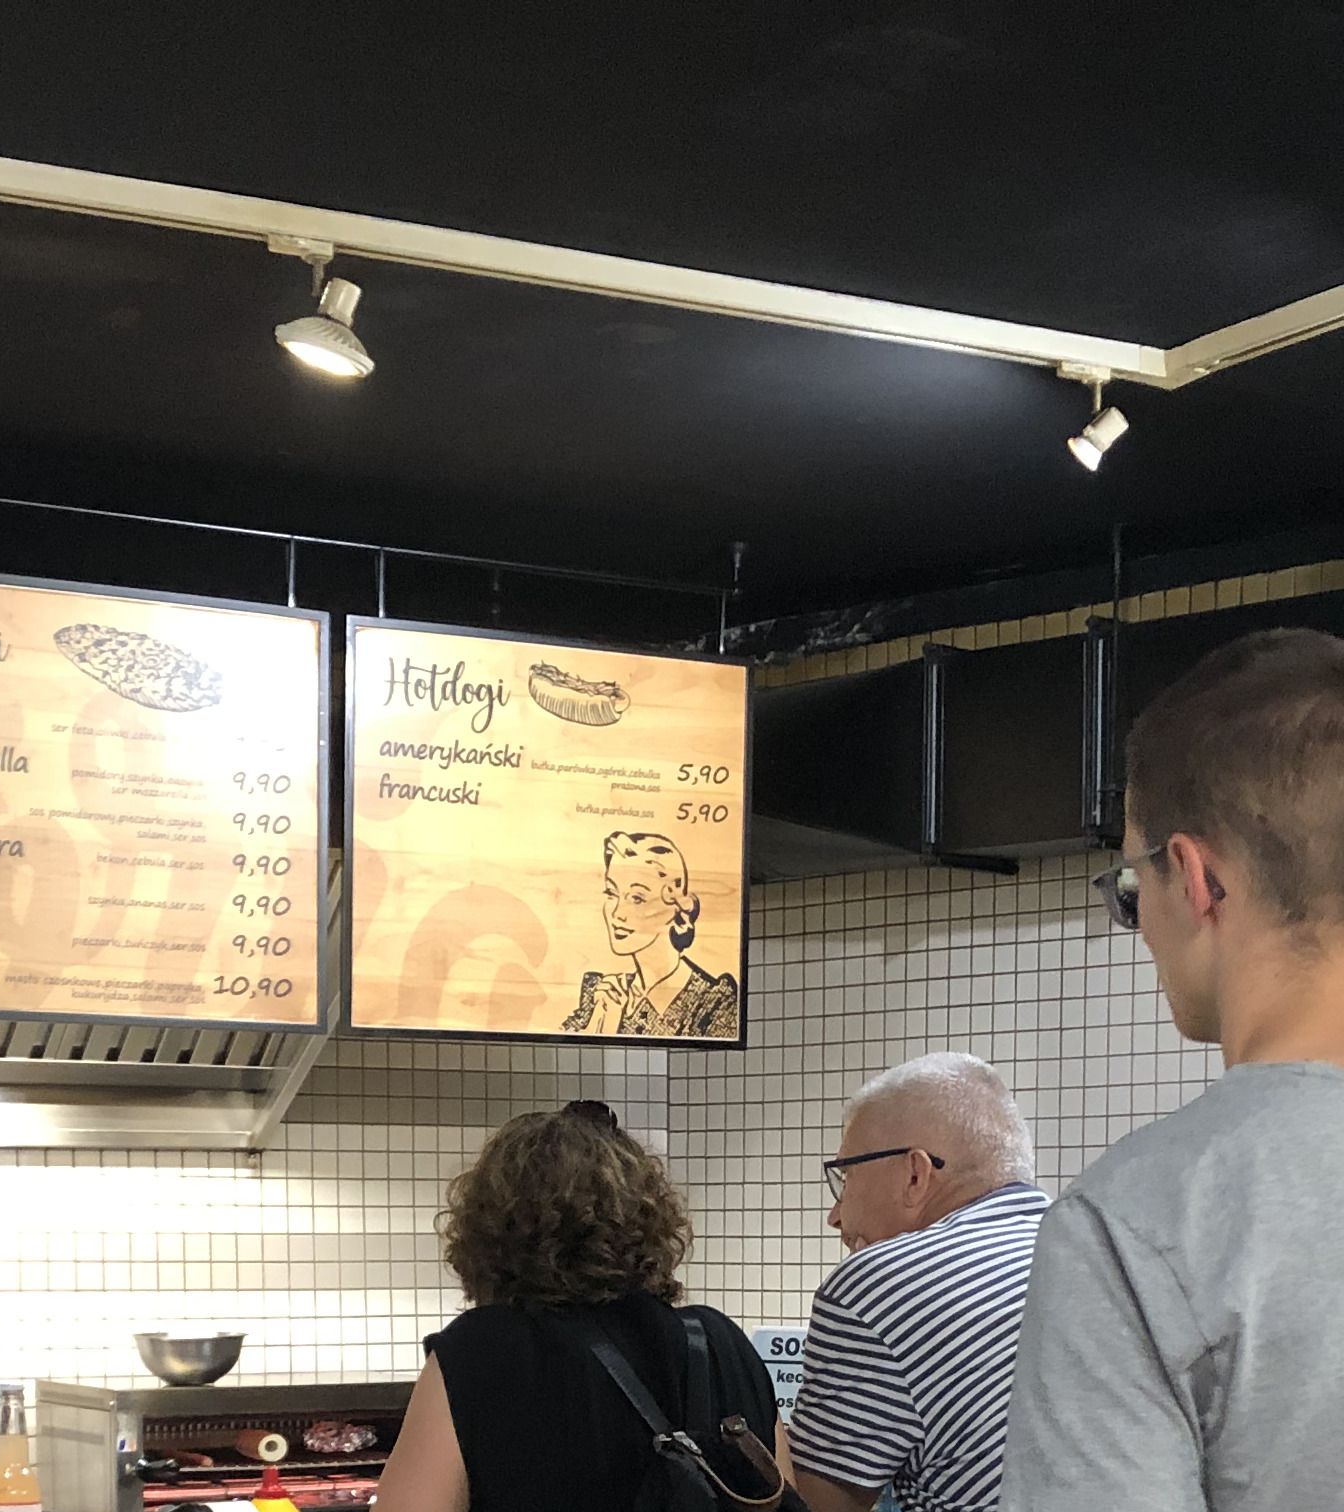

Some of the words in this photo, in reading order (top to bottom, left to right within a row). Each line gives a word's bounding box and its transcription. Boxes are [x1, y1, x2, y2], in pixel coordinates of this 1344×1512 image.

[383, 657, 511, 733] Hotdogi
[379, 739, 524, 769] amerykański
[232, 771, 291, 794] 9,90
[677, 763, 730, 786] 5,90
[379, 773, 482, 805] francuski
[232, 812, 291, 836] 9,90
[676, 802, 729, 825] 5,90
[232, 853, 291, 877] 9,90
[232, 894, 291, 918] 9,90
[232, 934, 291, 958] 9,90
[212, 974, 292, 999] 10,90
